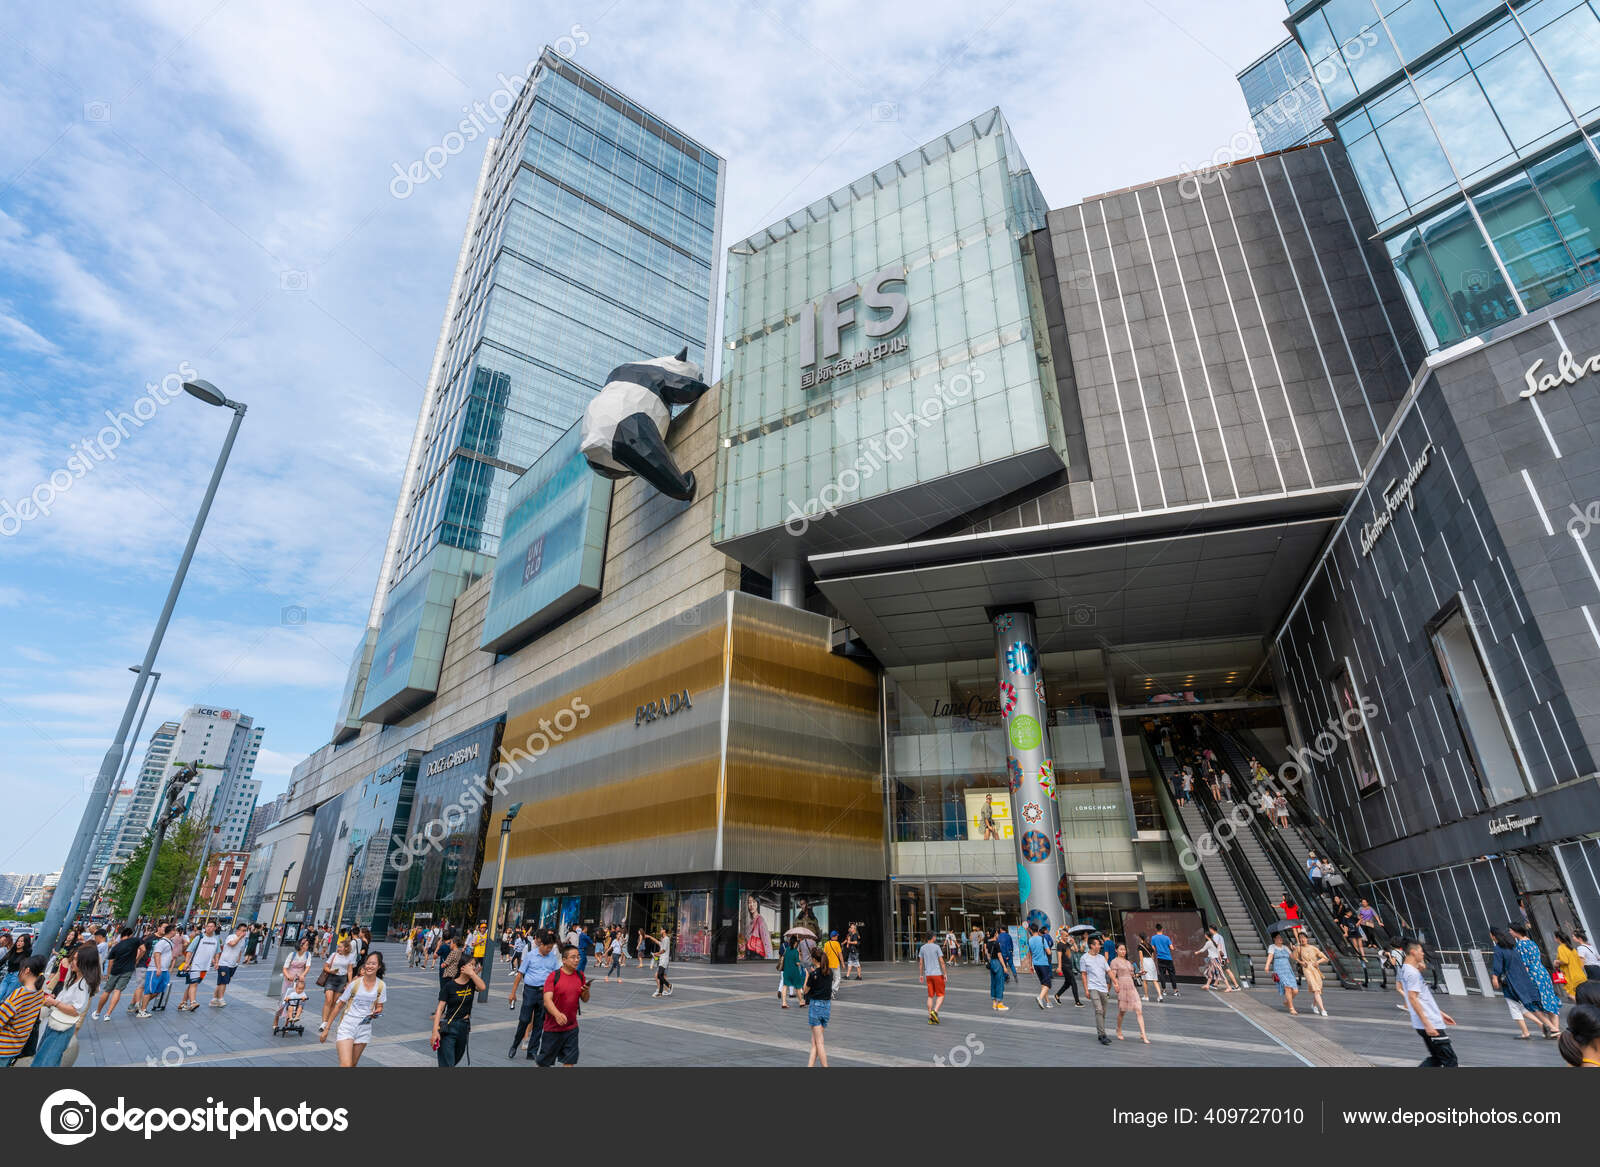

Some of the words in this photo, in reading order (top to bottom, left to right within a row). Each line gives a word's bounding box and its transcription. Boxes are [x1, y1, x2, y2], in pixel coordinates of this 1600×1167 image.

[800, 265, 909, 369] IFS
[801, 335, 908, 390] 国际金融中心
[1383, 442, 1432, 520] Ferragamo
[198, 708, 219, 717] ICBC
[635, 689, 693, 726] PRADA
[770, 879, 800, 889] PRADA
